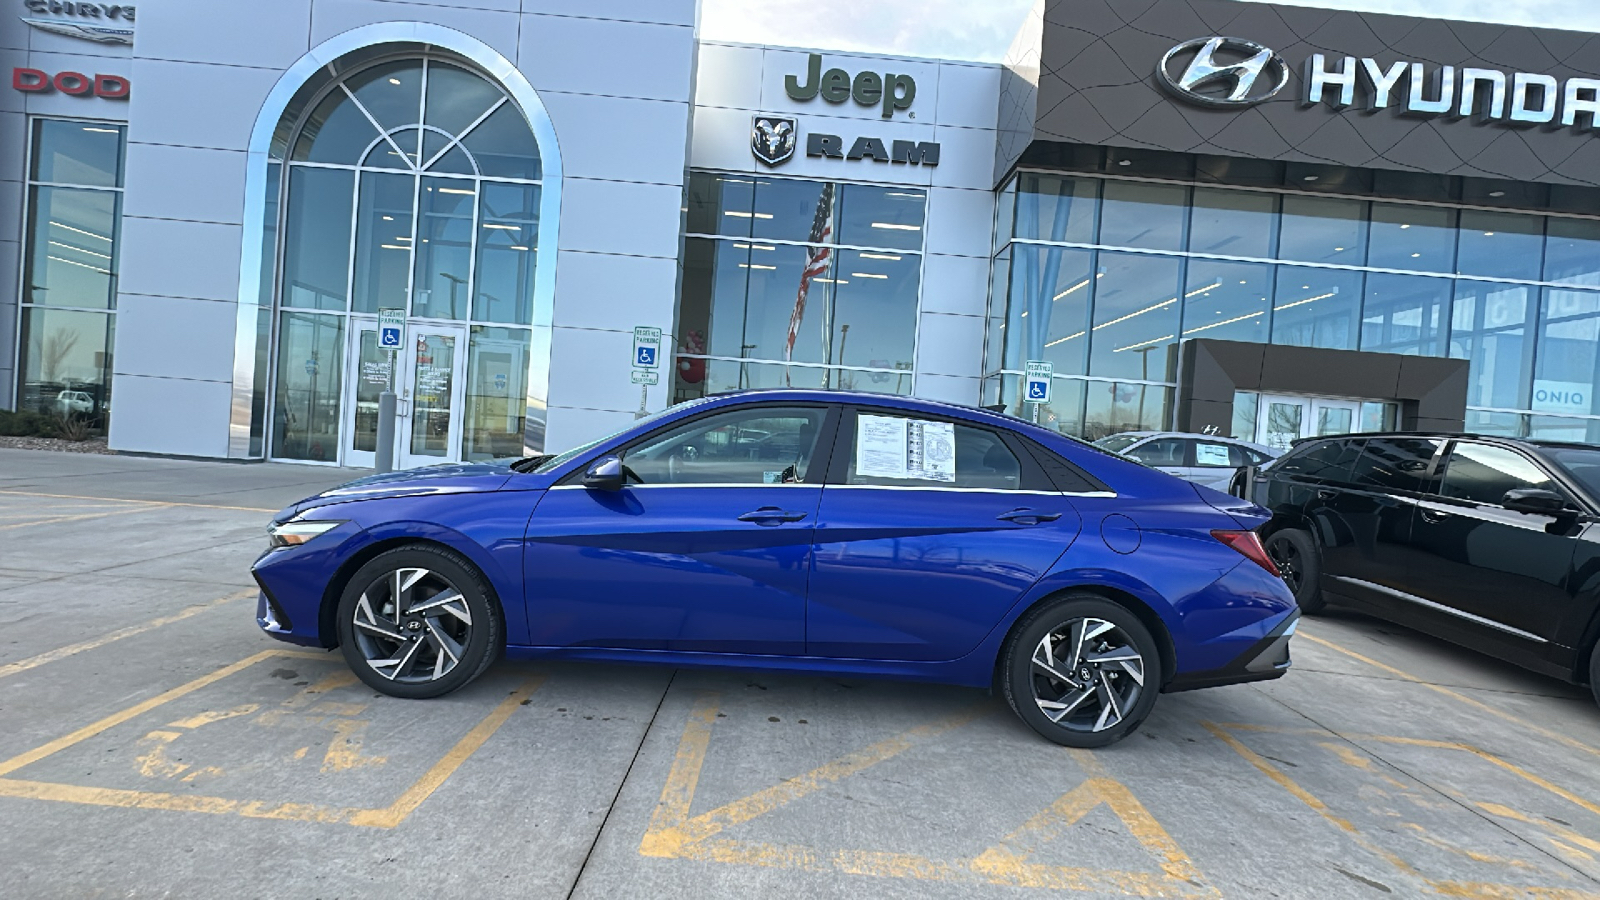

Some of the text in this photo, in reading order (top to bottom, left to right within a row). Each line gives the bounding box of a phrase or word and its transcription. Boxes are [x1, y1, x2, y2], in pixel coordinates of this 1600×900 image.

[13, 67, 130, 98] DOD
[785, 53, 916, 118] Jeep
[1309, 53, 1600, 127] HYUNDA
[807, 132, 941, 166] RAM
[381, 317, 404, 325] PARKING
